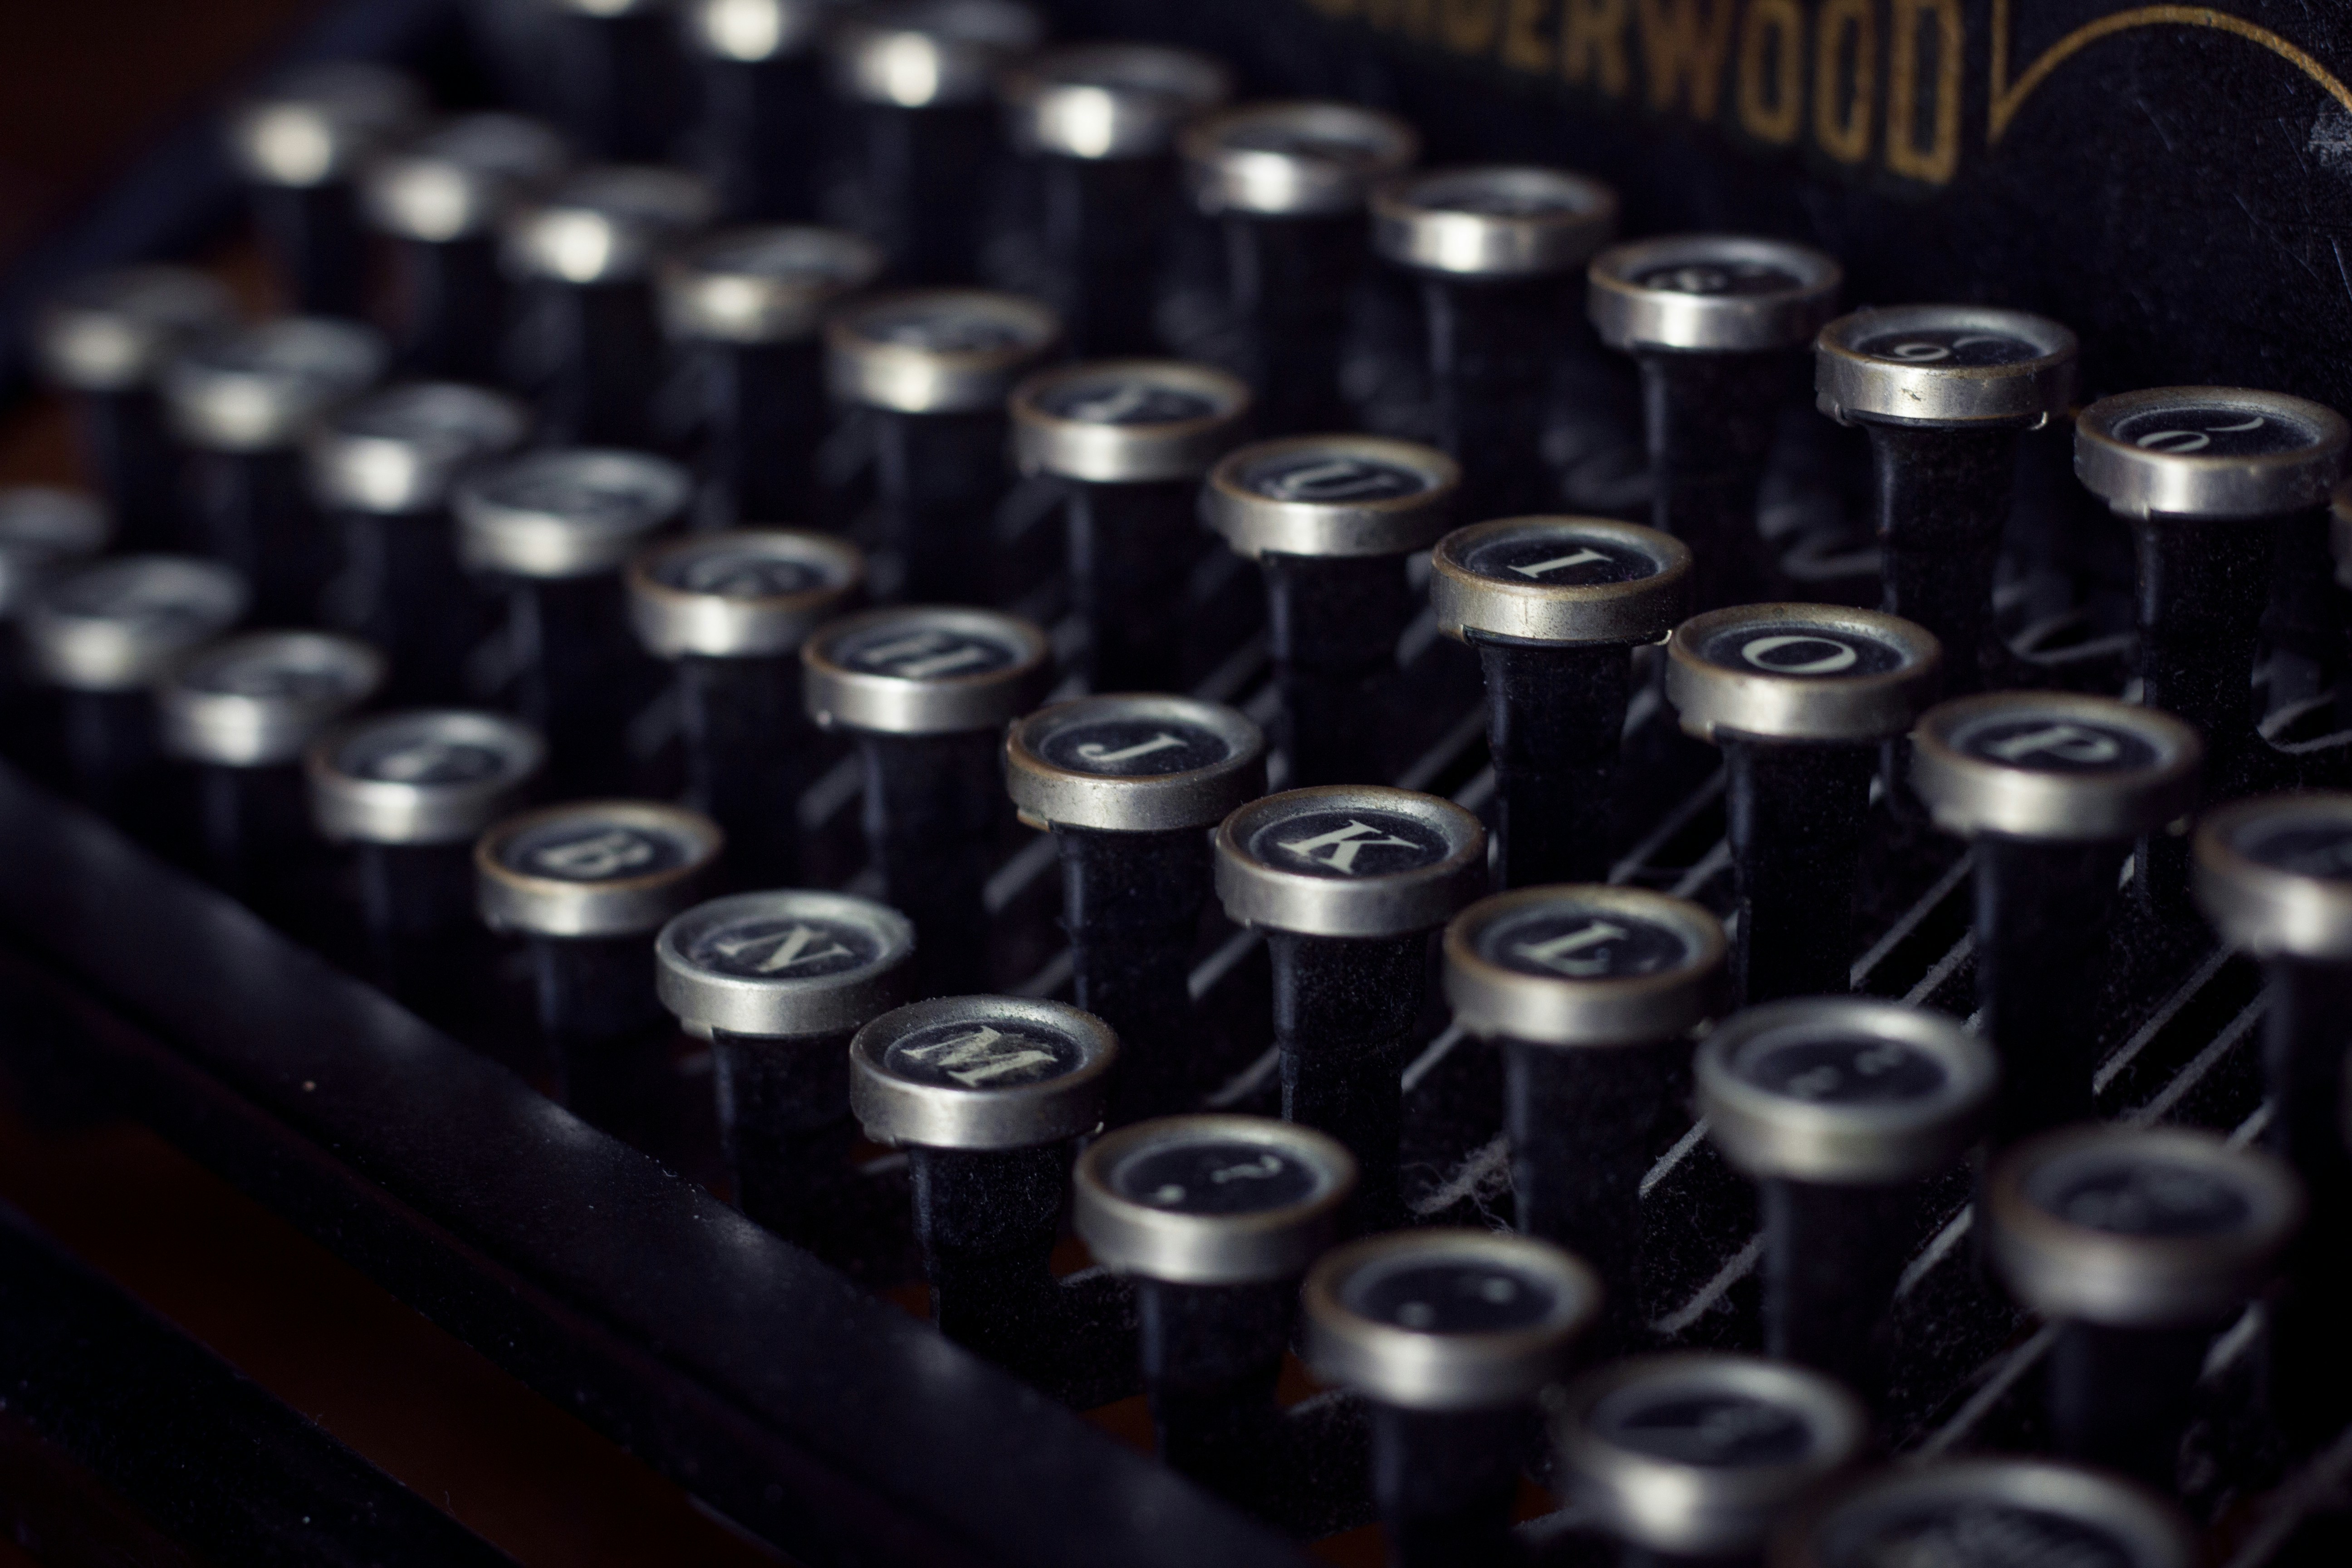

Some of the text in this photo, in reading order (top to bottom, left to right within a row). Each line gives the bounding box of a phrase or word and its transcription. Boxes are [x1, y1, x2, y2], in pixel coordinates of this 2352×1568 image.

[1506, 547, 1615, 578] I
[1741, 635, 1857, 674] O
[1077, 731, 1190, 762] J
[1984, 725, 2119, 764] P
[541, 830, 653, 879] B
[1276, 818, 1424, 875] K
[713, 924, 855, 973] N
[1515, 920, 1630, 976] L
[899, 1024, 1060, 1087] M
